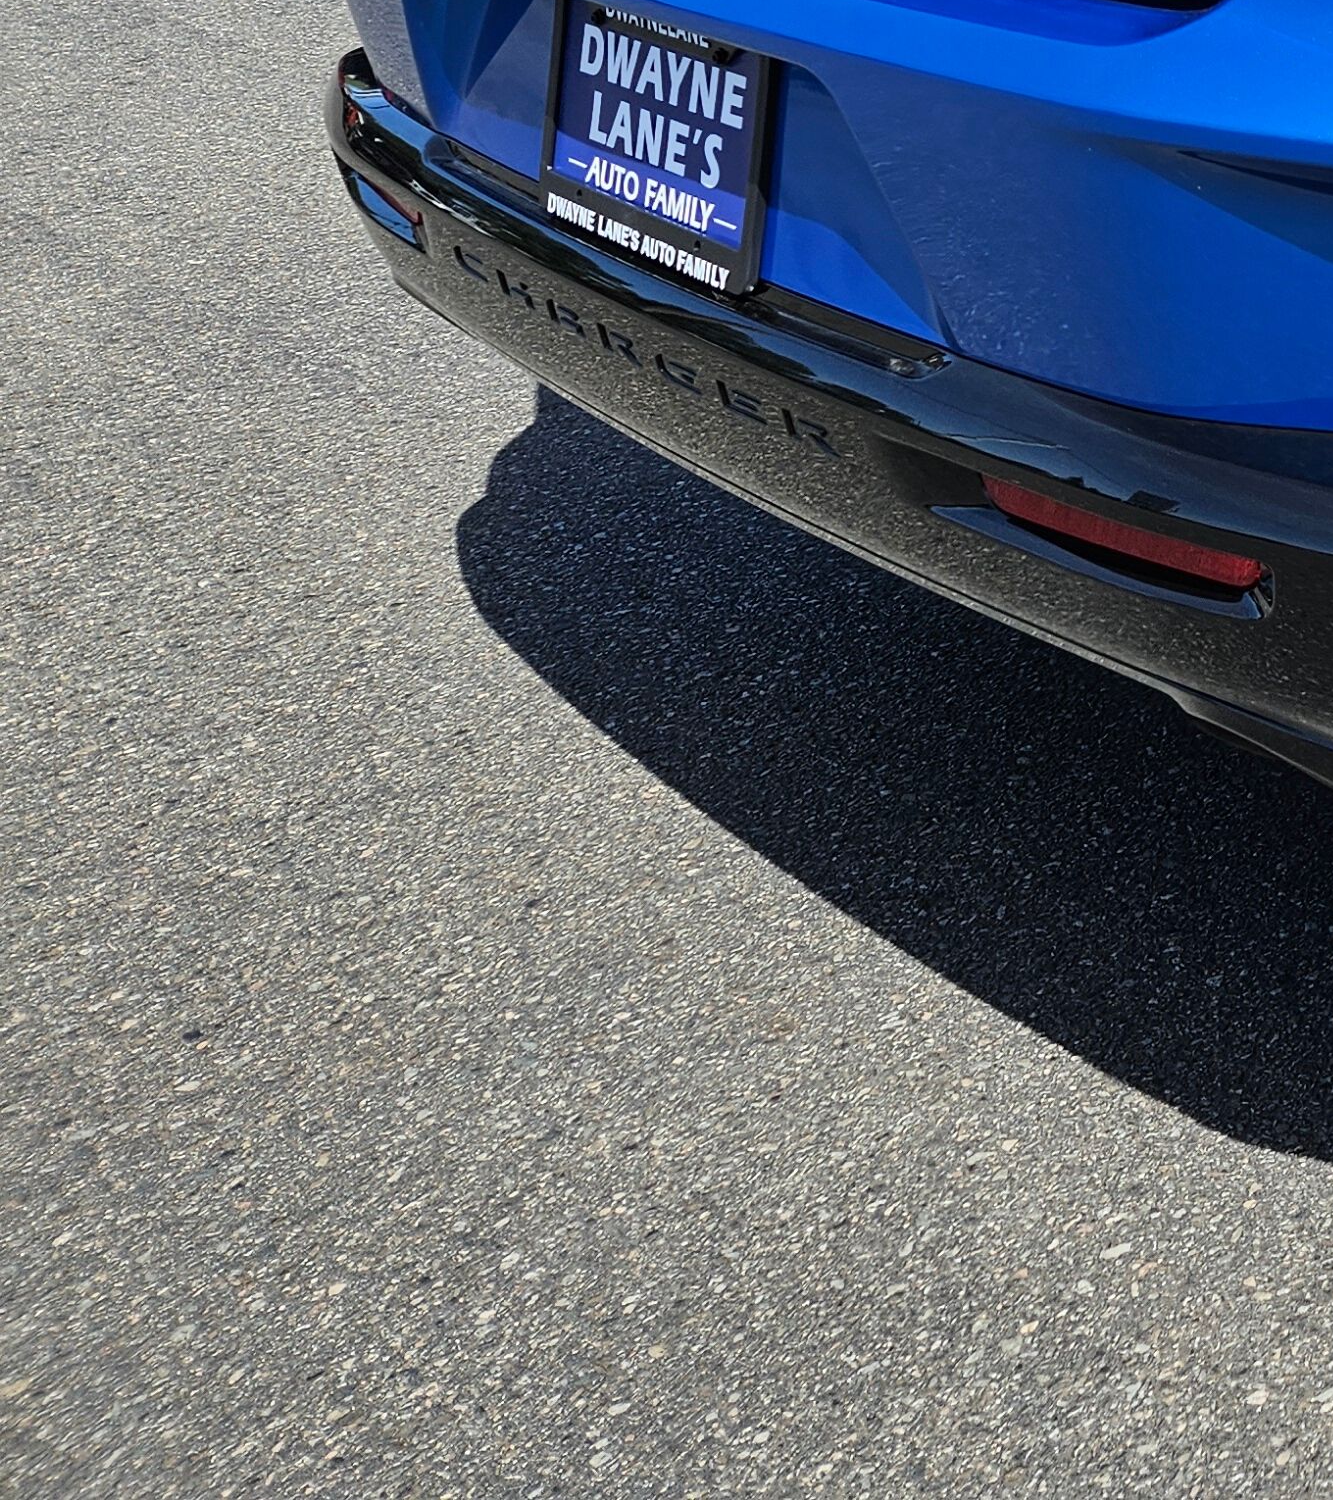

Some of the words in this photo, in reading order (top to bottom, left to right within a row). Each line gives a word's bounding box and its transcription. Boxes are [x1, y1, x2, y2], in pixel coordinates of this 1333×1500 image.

[579, 23, 747, 130] DWAYNE
[588, 90, 723, 189] LANE'S
[546, 192, 597, 232] DWAYNE
[597, 214, 640, 251] LANE'S
[639, 235, 676, 267] AUTO
[675, 249, 730, 291] FAMILY
[584, 156, 640, 201] AUTO
[643, 177, 716, 232] FAMILY
[453, 245, 841, 458] CHARGER
